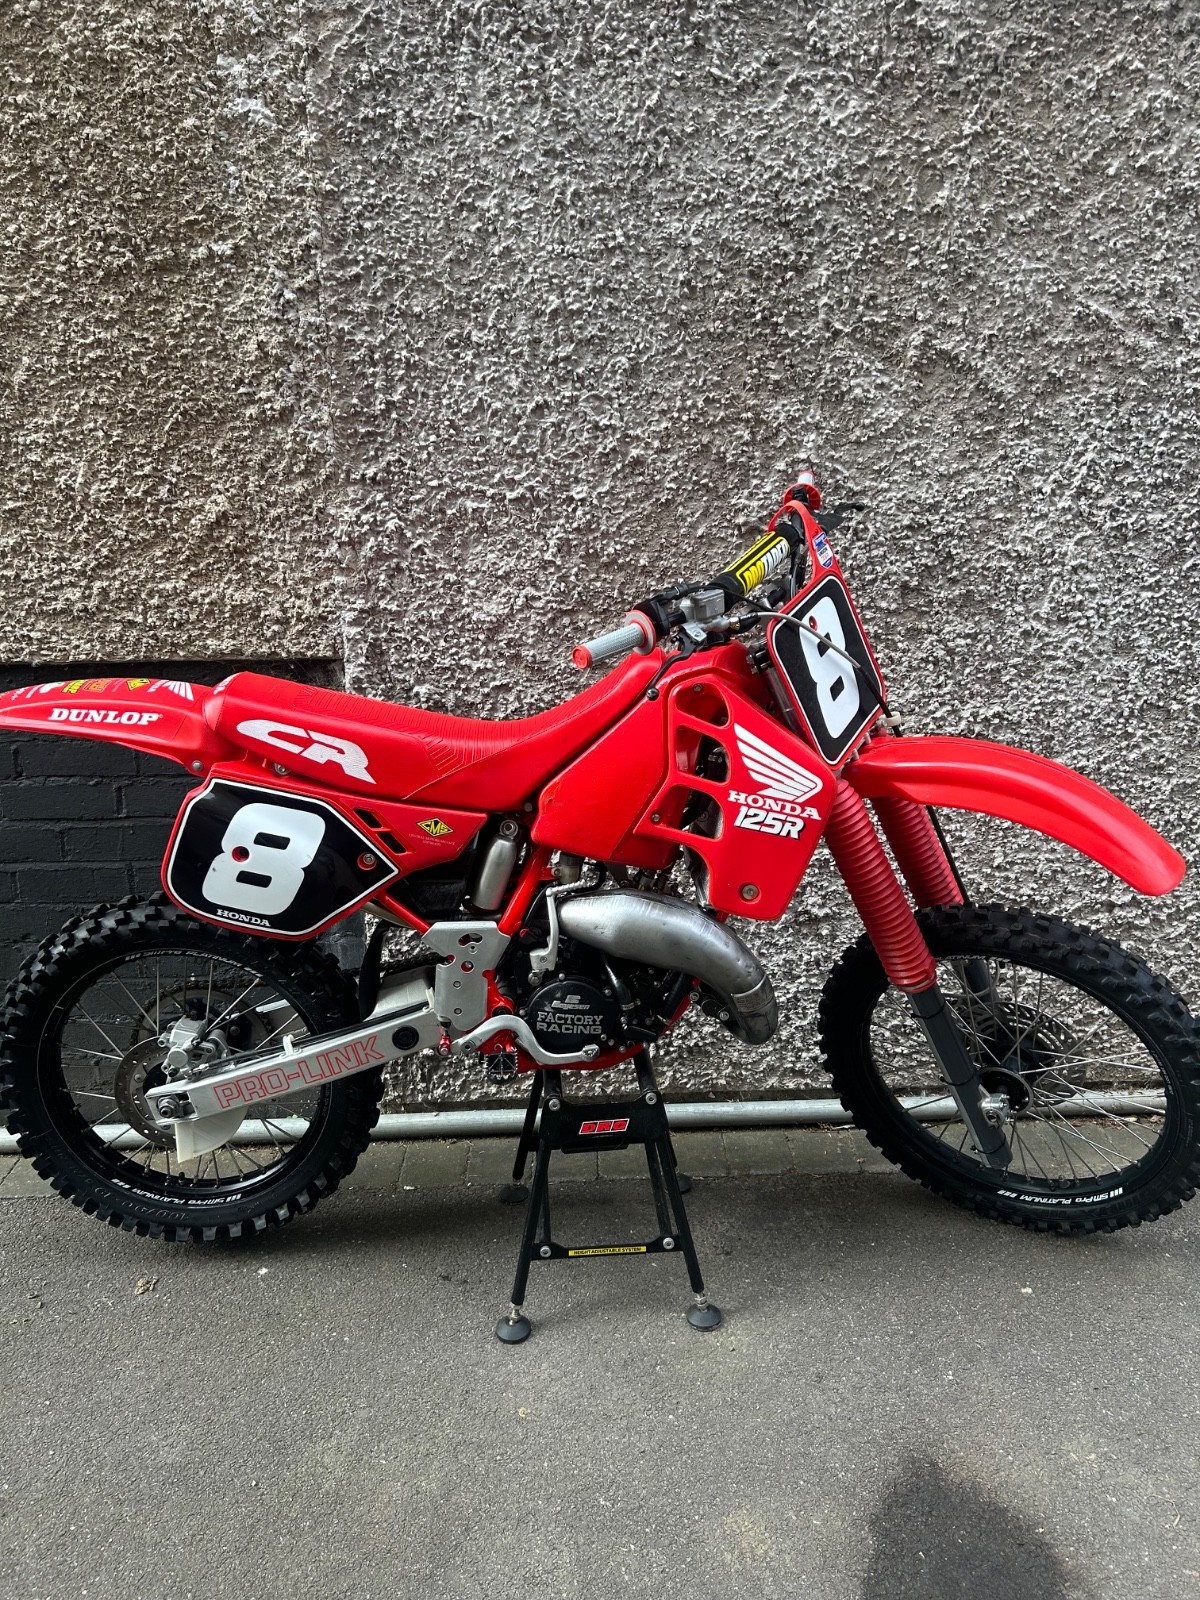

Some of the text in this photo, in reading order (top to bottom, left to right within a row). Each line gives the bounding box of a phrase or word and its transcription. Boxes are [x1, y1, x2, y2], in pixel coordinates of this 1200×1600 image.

[799, 596, 860, 739] 8
[48, 708, 160, 726] DUNLOP
[236, 719, 377, 785] CR
[727, 790, 822, 820] HONDA
[420, 819, 448, 835] CMS
[734, 805, 805, 840] 125R
[201, 803, 326, 916] 8
[216, 908, 271, 927] HONDA
[186, 951, 243, 967] PLATINUM
[537, 1011, 604, 1025] FACTORY
[536, 1022, 602, 1034] RACING
[213, 1035, 385, 1109] PRO-LINK
[580, 1120, 628, 1134] DRC
[131, 1187, 186, 1206] PLATINUM
[1019, 1194, 1072, 1205] PLATINUM
